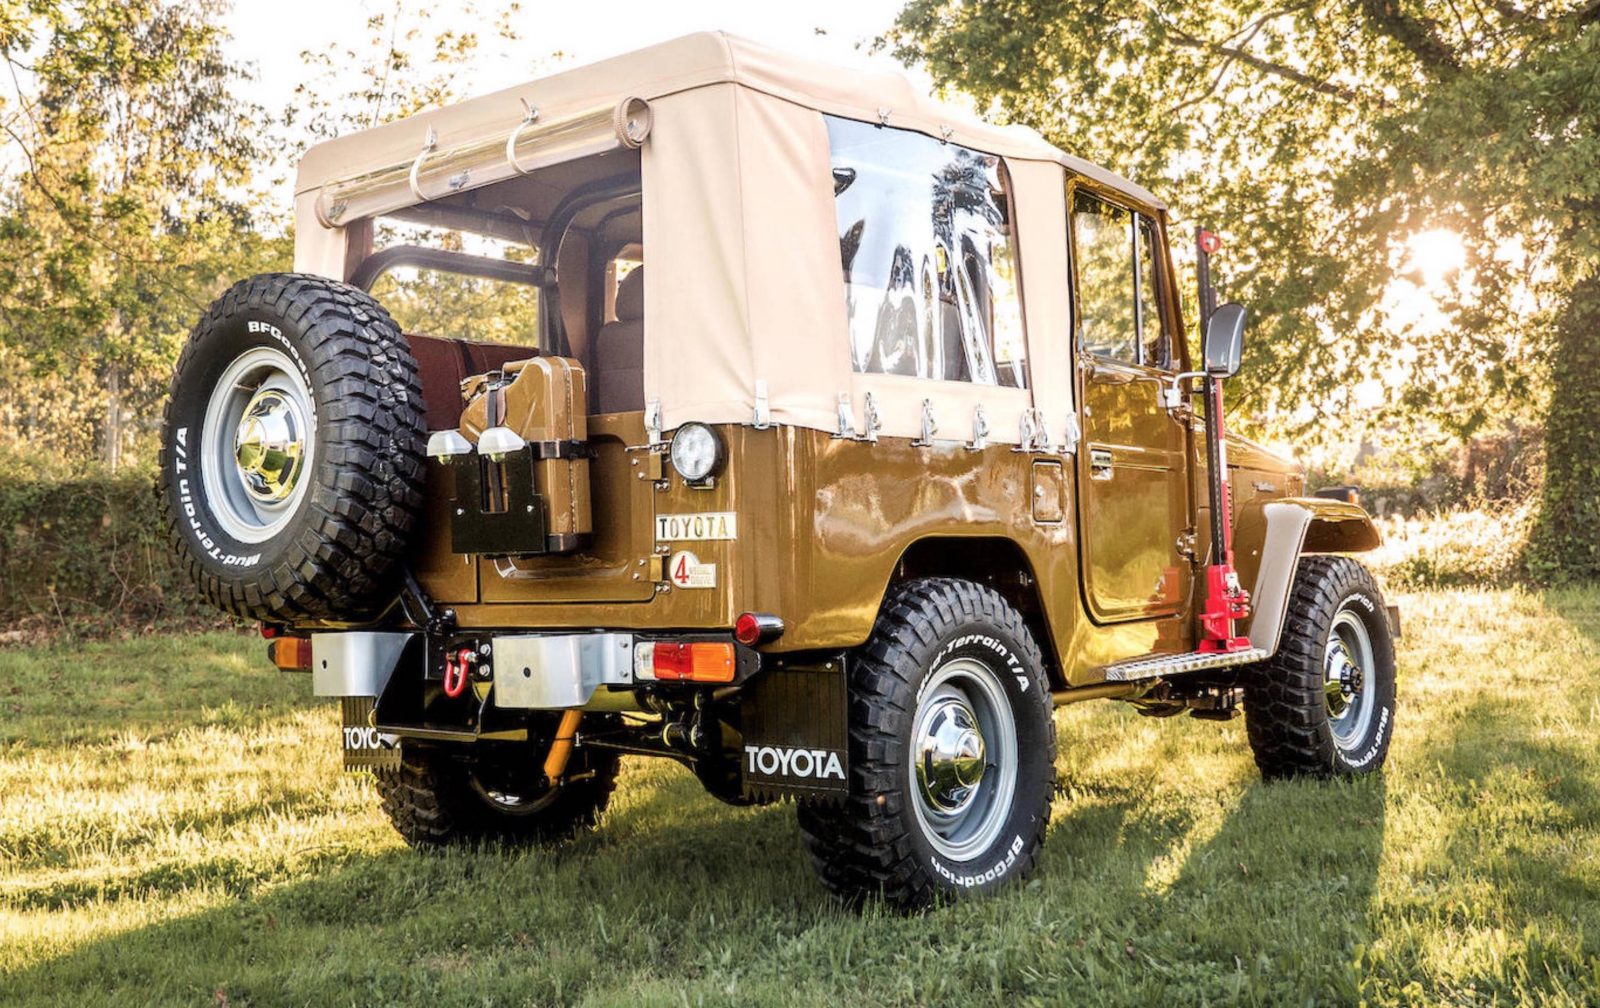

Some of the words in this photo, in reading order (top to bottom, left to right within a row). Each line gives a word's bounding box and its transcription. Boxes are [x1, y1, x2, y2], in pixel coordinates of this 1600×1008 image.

[175, 427, 188, 474] T/A
[179, 479, 261, 567] Mud-Terrain
[659, 516, 728, 538] TOYOTA
[674, 555, 690, 584] 4
[1006, 652, 1030, 693] T/A
[343, 726, 401, 750] TOYO
[744, 745, 846, 780] TOYOTA
[930, 834, 1024, 888] BFGoodrich
